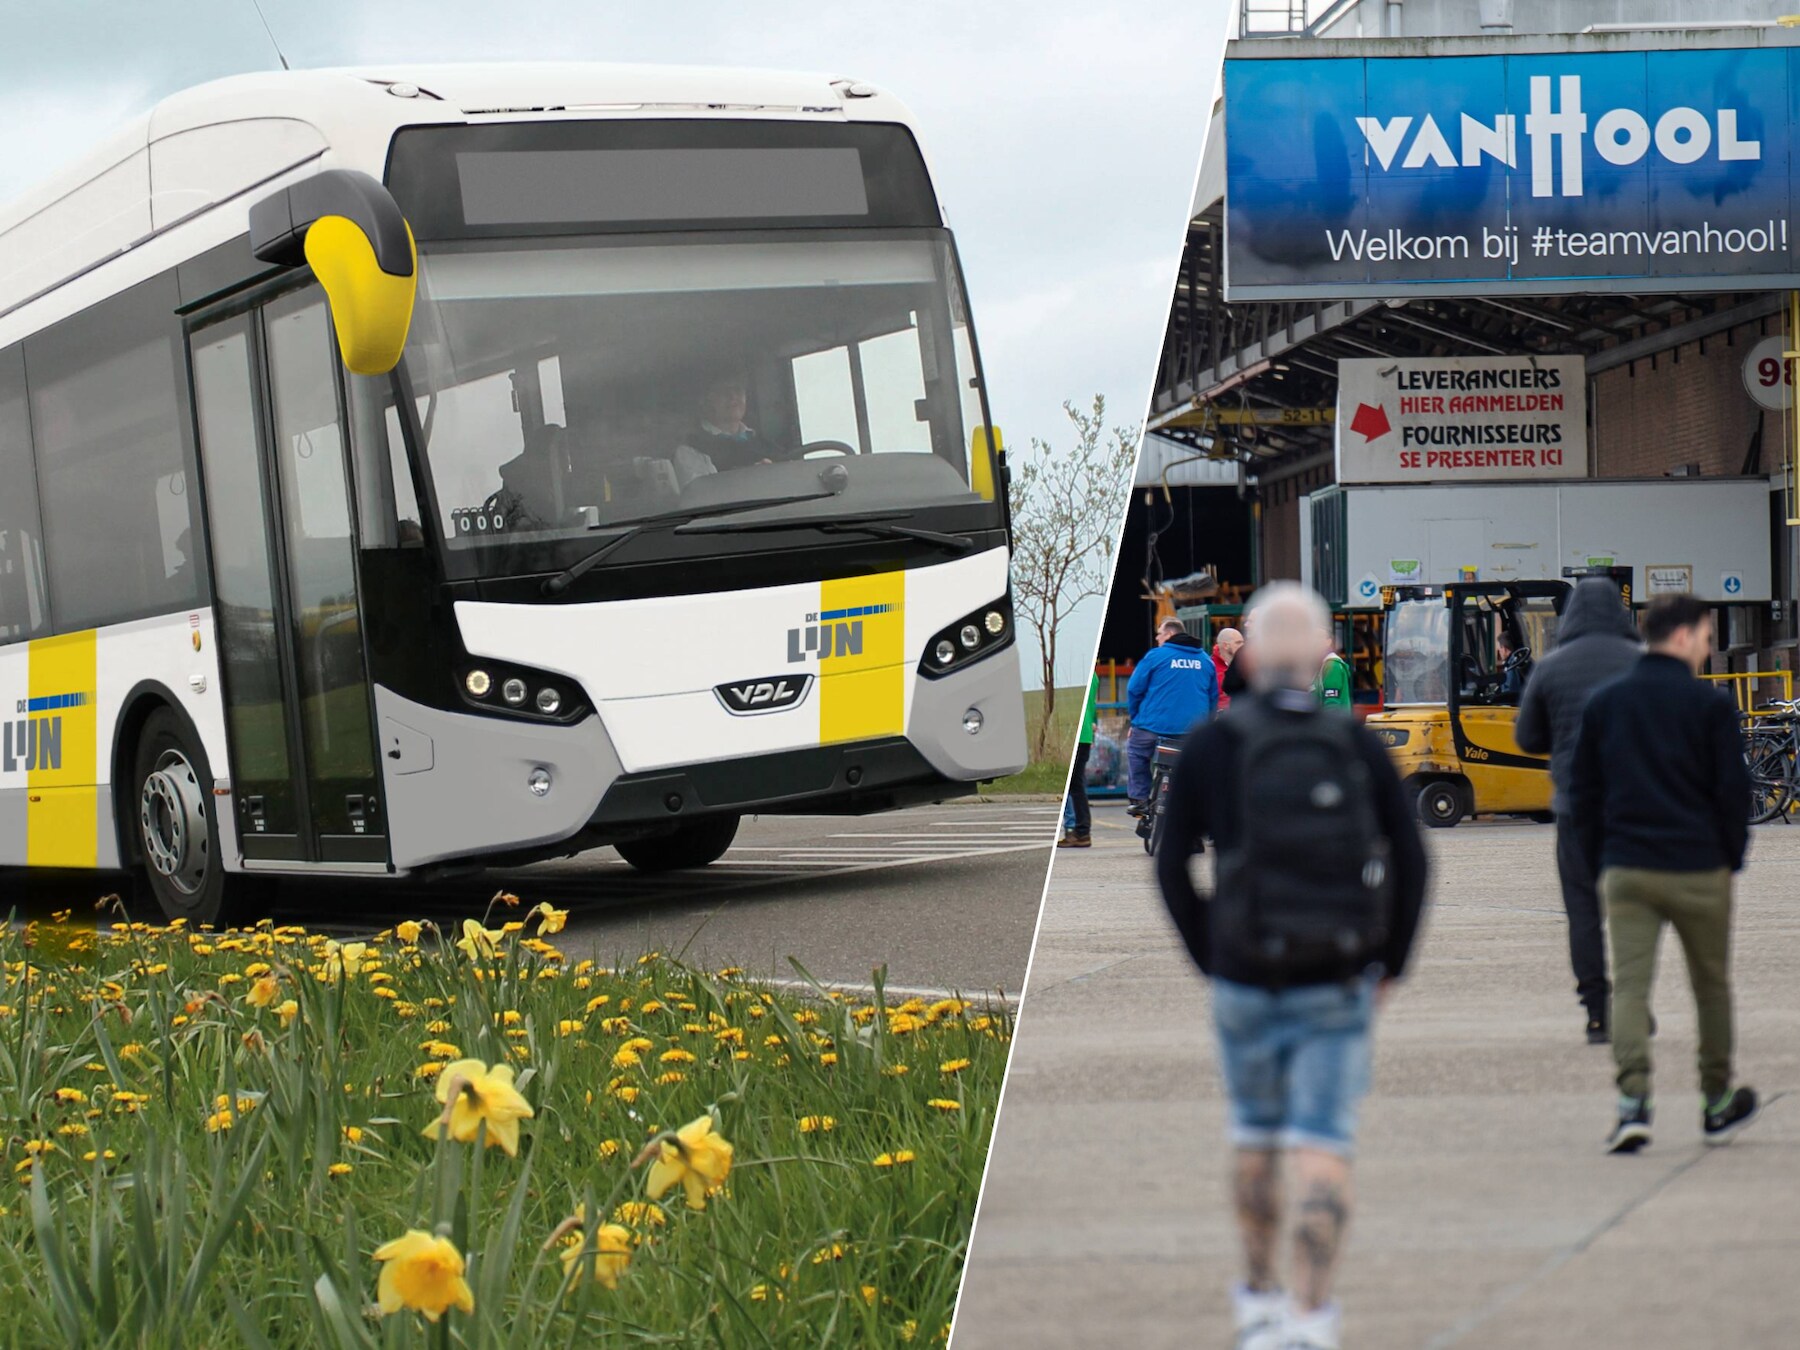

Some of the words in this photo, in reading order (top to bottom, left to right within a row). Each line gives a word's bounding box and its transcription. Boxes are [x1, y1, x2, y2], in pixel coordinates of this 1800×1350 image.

[1326, 229, 1469, 261] Welkom
[1483, 226, 1519, 265] bij
[1532, 219, 1787, 257] #teamvanhool!
[1397, 369, 1561, 391] LEVERANCIERS
[1400, 396, 1445, 415] HIER
[1449, 394, 1564, 414] AANMELDEN
[1402, 424, 1562, 447] FOURNISSEURS
[1400, 451, 1421, 468] SE
[1426, 449, 1536, 469] PRESENTER
[1541, 449, 1563, 466] ICI
[805, 612, 818, 623] DE
[787, 620, 863, 663] LIJN
[1170, 659, 1202, 670] ACLVB
[730, 681, 795, 704] VDL
[16, 699, 27, 713] DE
[3, 716, 62, 772] LIJN
[1464, 746, 1489, 761] Yale
